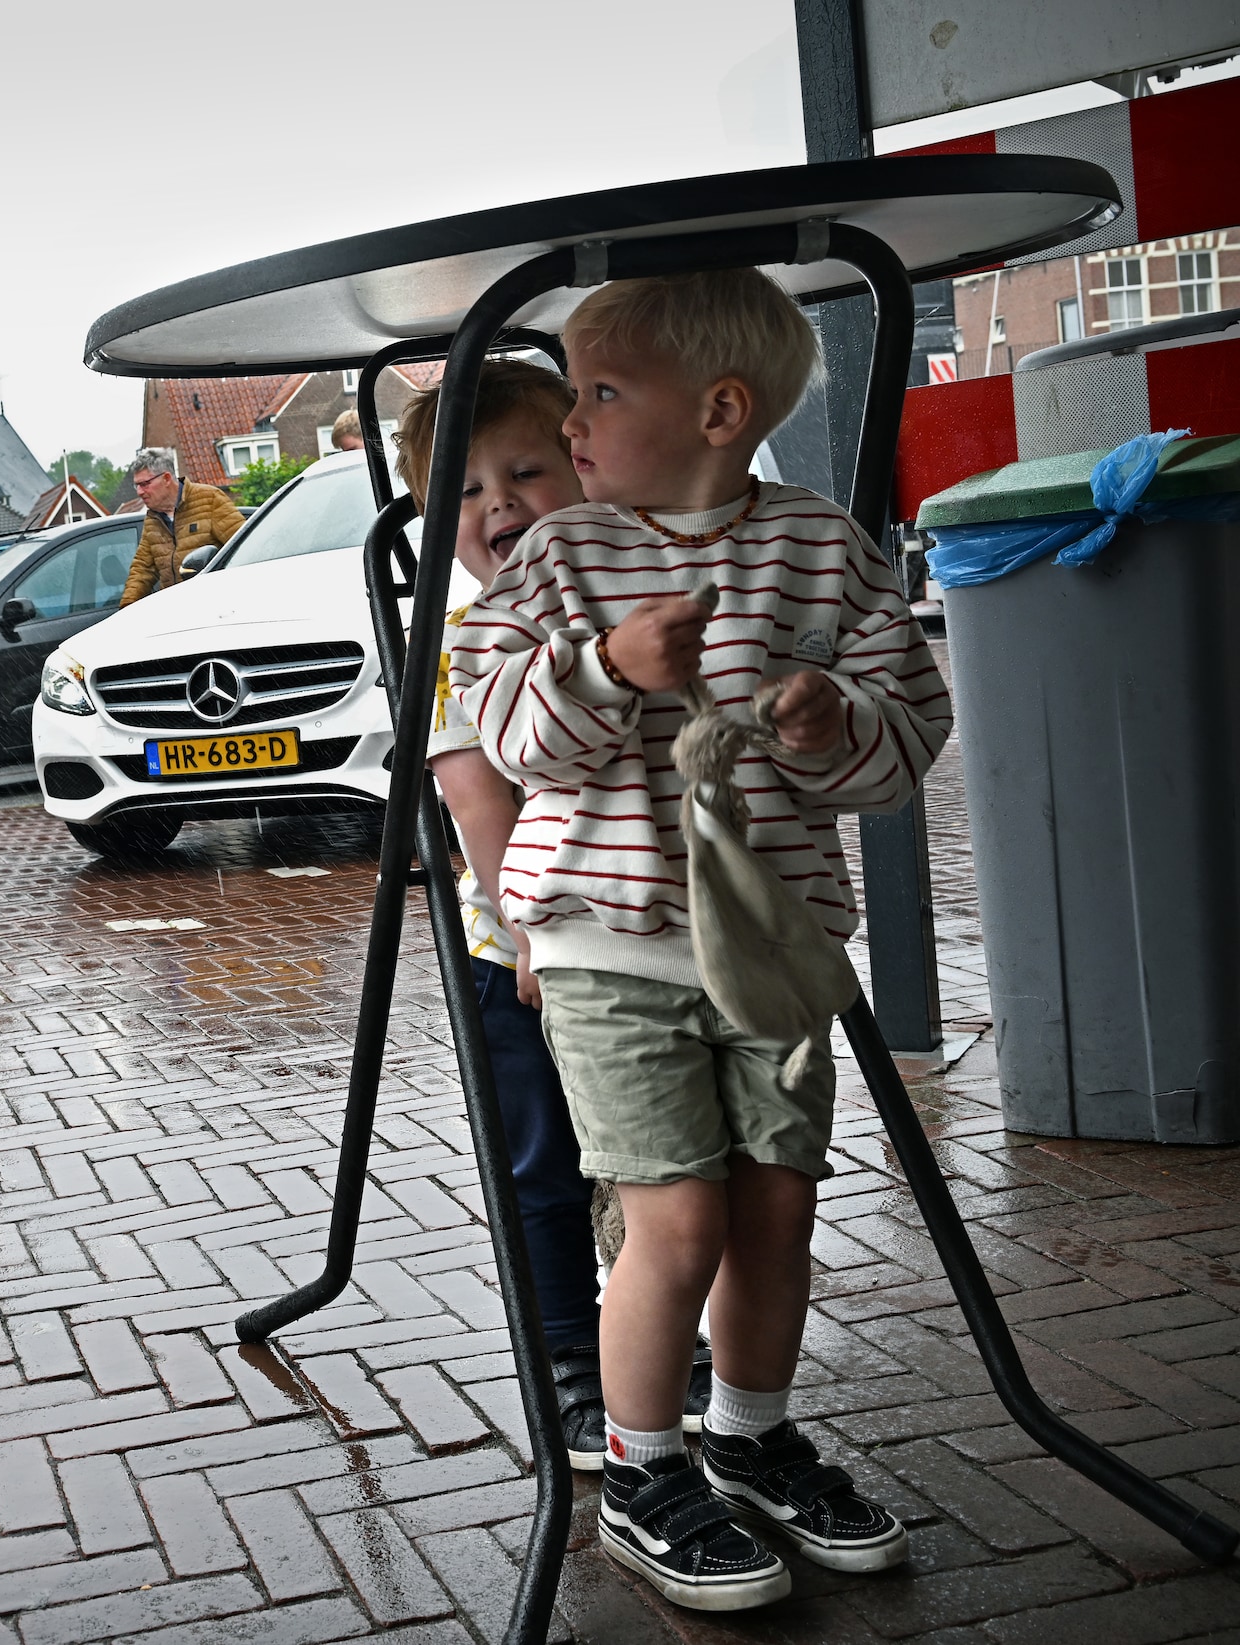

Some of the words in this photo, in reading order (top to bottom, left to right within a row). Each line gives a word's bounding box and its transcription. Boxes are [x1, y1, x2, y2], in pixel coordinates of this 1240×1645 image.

[797, 629, 823, 646] SUNDAY
[165, 737, 286, 770] HR-683-D
[149, 761, 159, 770] NL
